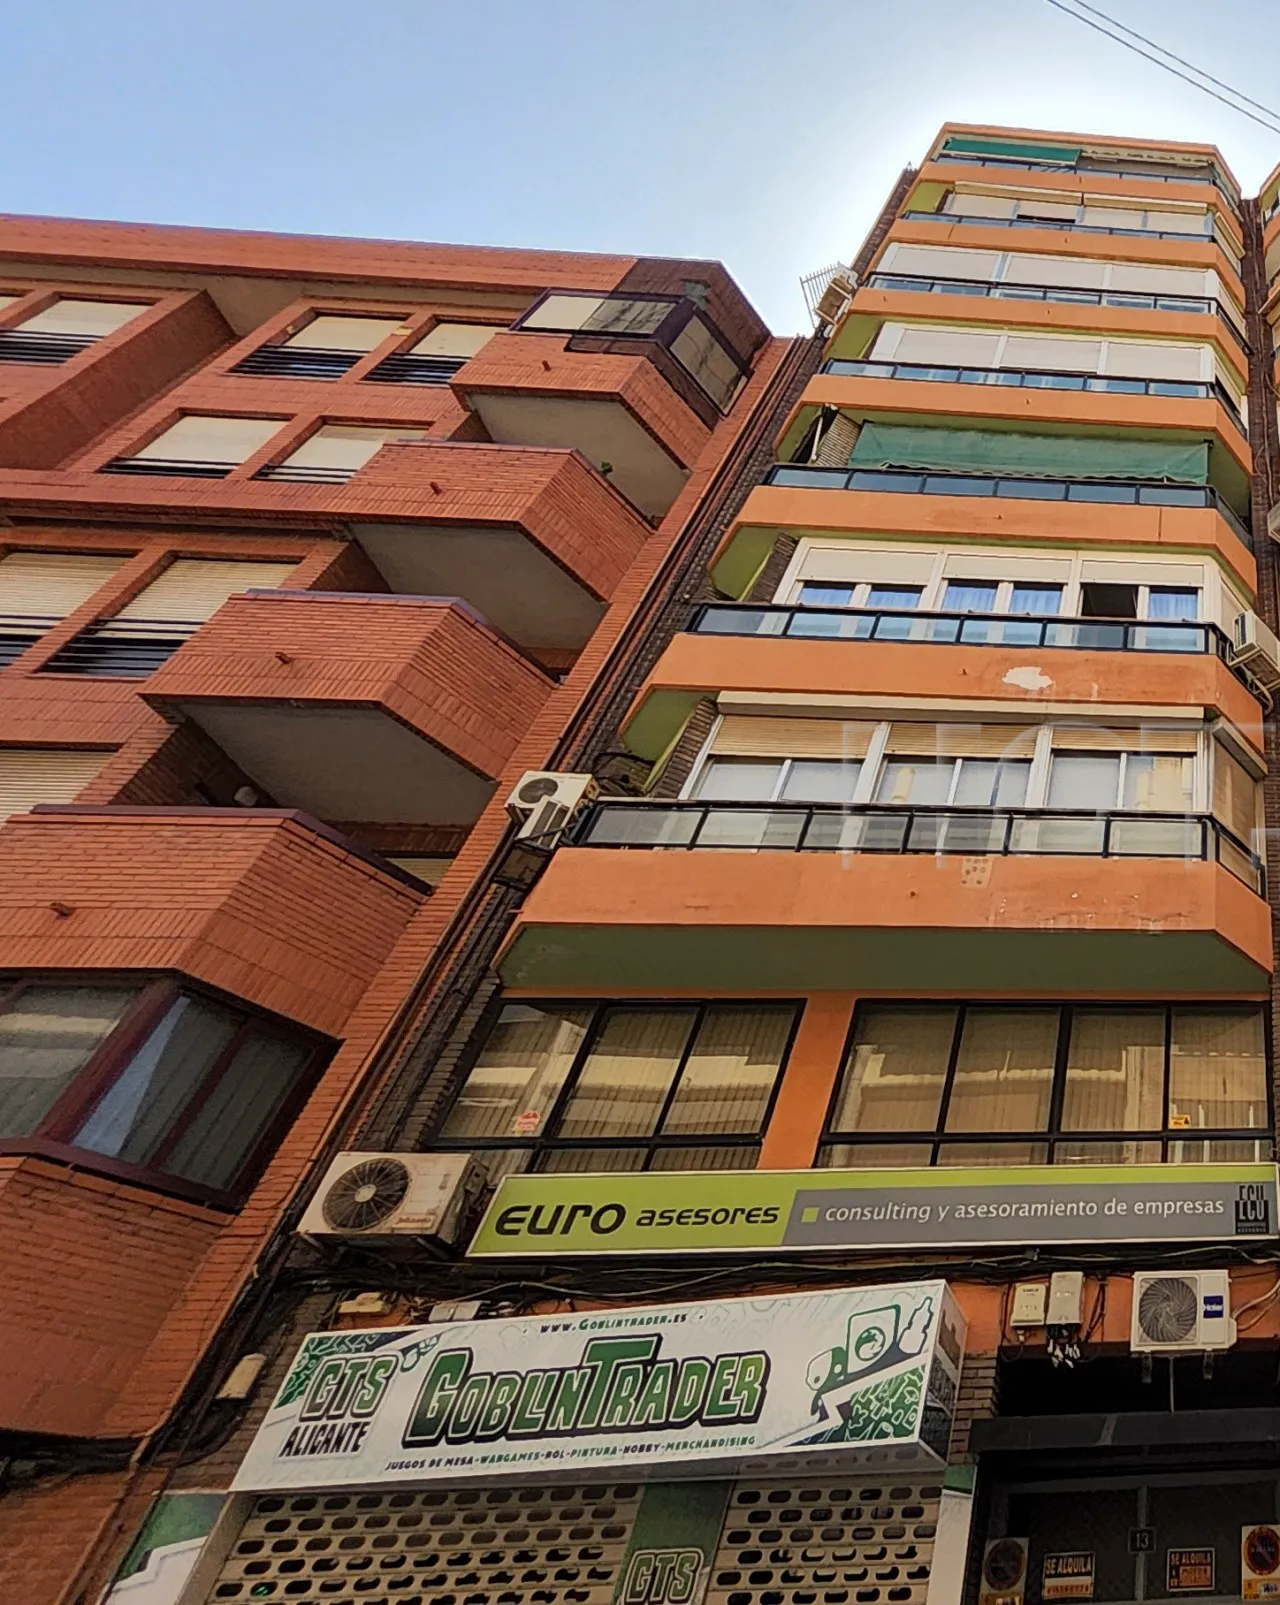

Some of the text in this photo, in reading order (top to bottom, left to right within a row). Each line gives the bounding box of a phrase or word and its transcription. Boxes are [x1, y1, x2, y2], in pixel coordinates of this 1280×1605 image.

[636, 1206, 780, 1227] asesores
[824, 1197, 1225, 1223] consulting y asesoramiento de empresas
[299, 1354, 400, 1422] GTS
[278, 1421, 371, 1458] ALICANTE
[384, 1459, 425, 1471] JUEGOS
[429, 1457, 442, 1468] DE
[1136, 1532, 1149, 1549] 13
[1045, 1555, 1092, 1575] SE ALQUILA
[1181, 1551, 1212, 1564] ALQUILA
[624, 1550, 702, 1605] GTS
